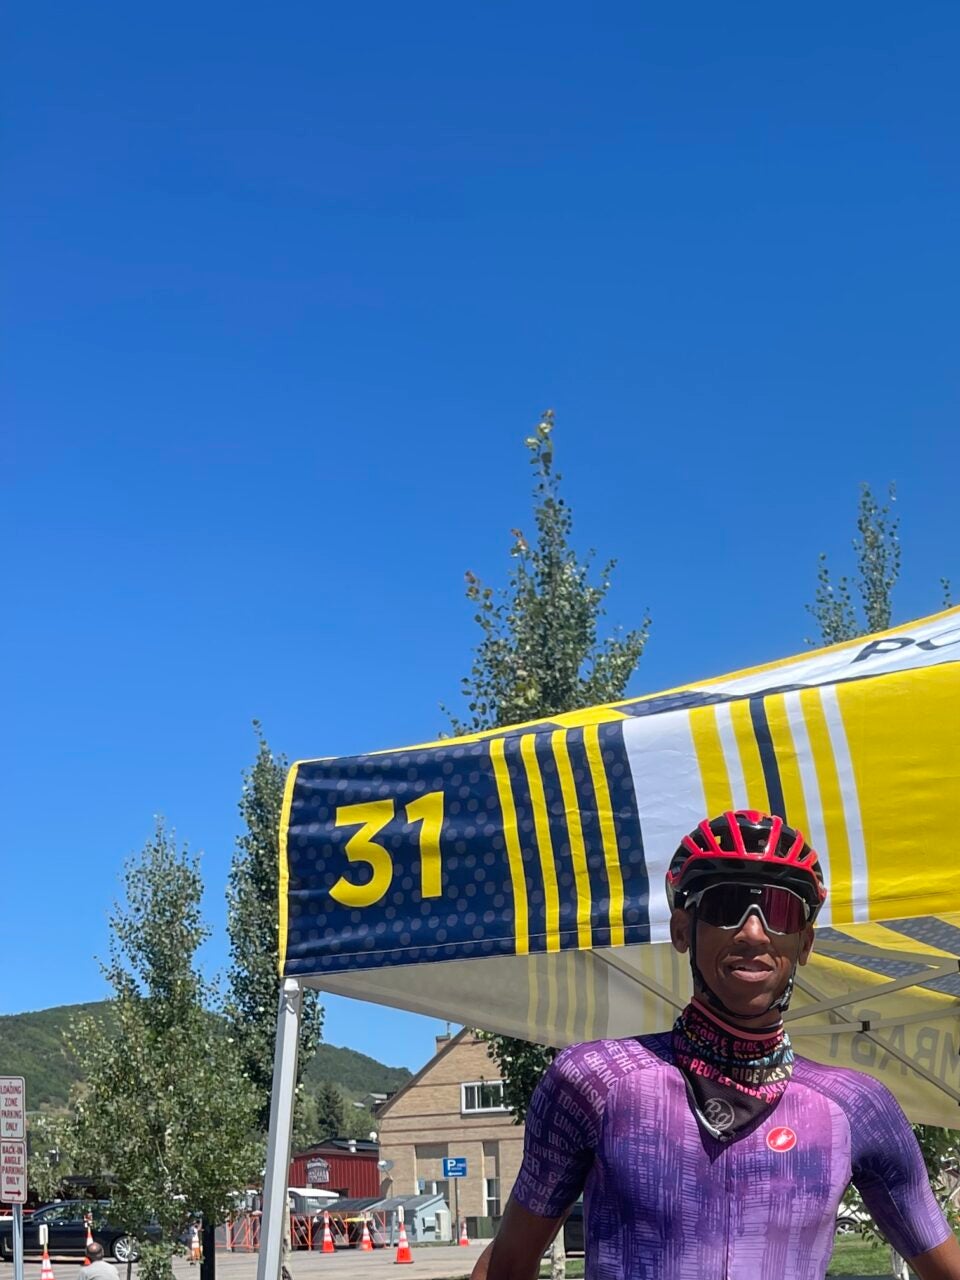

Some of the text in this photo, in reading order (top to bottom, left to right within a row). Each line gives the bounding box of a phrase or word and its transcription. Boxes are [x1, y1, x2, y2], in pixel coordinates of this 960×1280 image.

[329, 791, 444, 908] 31
[5, 1097, 18, 1107] ZONE
[0, 1110, 22, 1119] PARKING
[5, 1122, 18, 1131] ONLY
[4, 1156, 20, 1165] ANGLE
[447, 1159, 457, 1171] P
[1, 1166, 24, 1175] PARKING
[5, 1177, 19, 1186] ONLY
